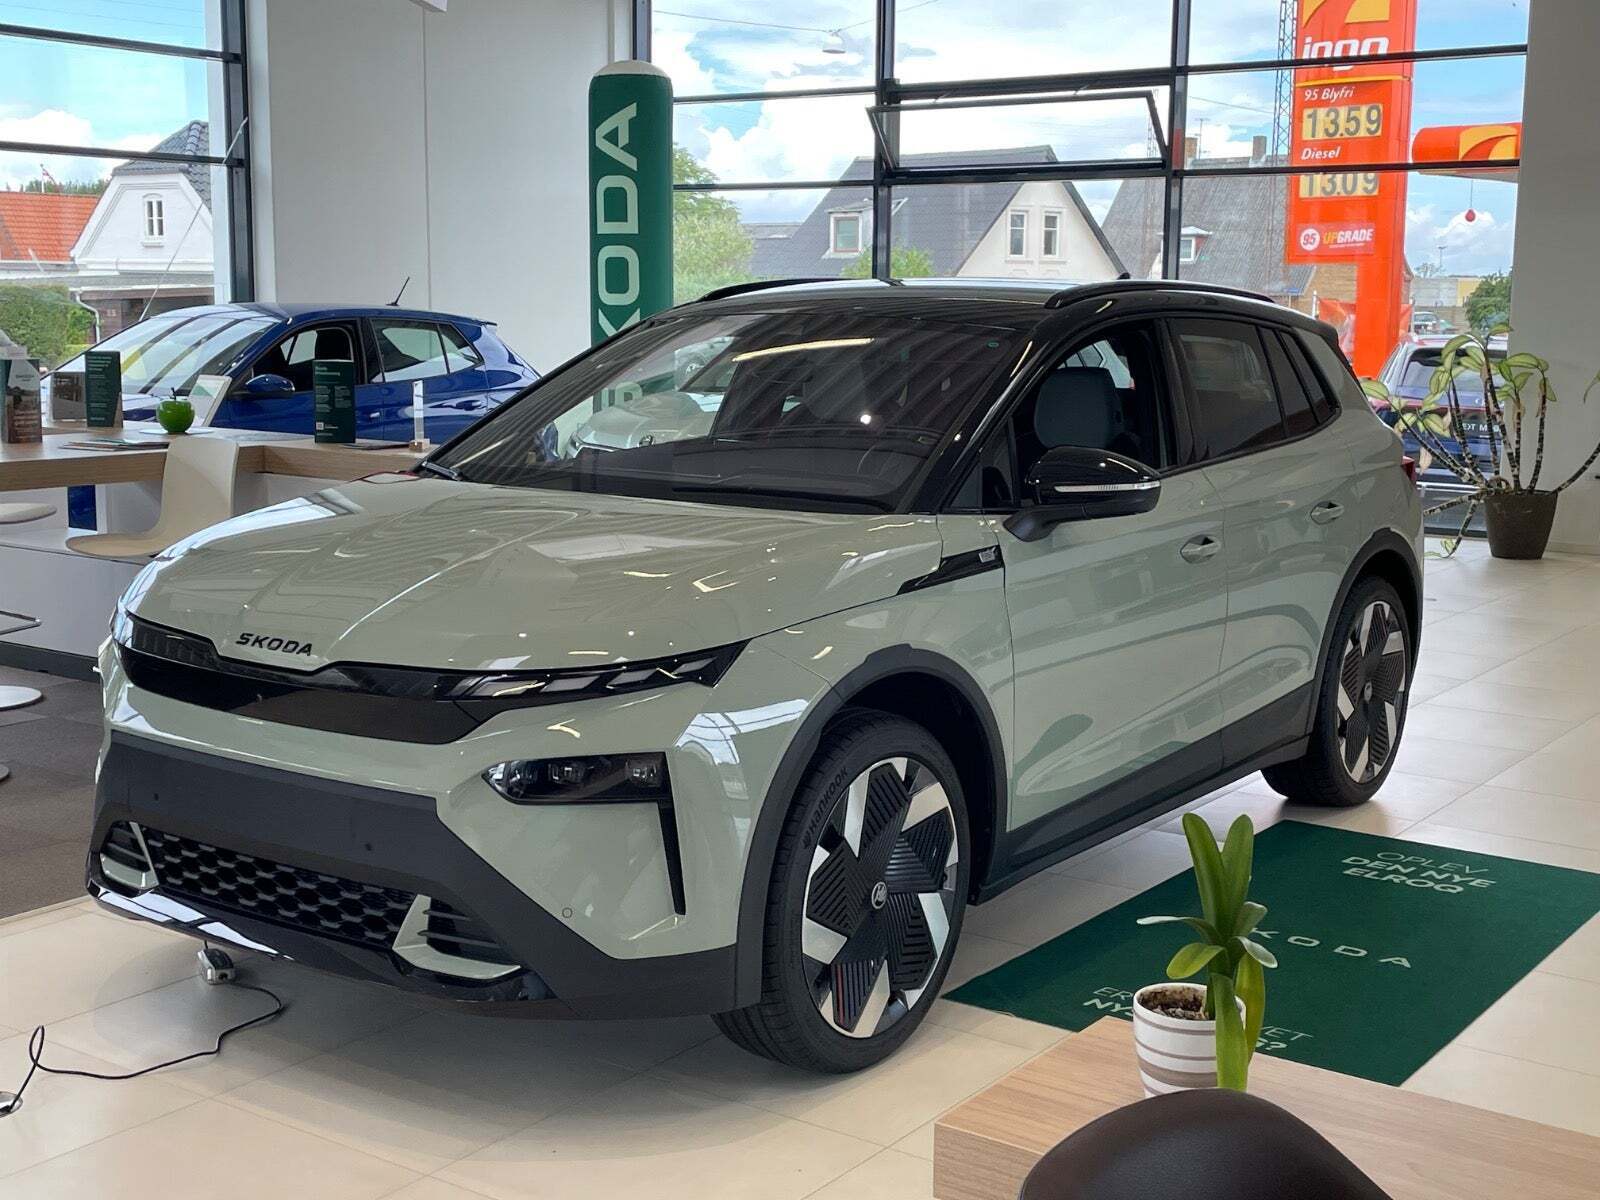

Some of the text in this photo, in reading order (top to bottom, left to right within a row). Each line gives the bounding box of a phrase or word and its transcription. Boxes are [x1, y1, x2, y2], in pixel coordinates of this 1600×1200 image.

[1304, 86, 1355, 104] 95 Blyfri
[1306, 104, 1382, 138] 13.59
[1301, 146, 1341, 160] Diesel
[1302, 228, 1374, 246] 95 UPGRADE
[1341, 856, 1496, 888] DEN NYE
[1376, 852, 1489, 874] OPLEV
[1342, 868, 1465, 894] ELROQ
[1252, 927, 1412, 969] KODA
